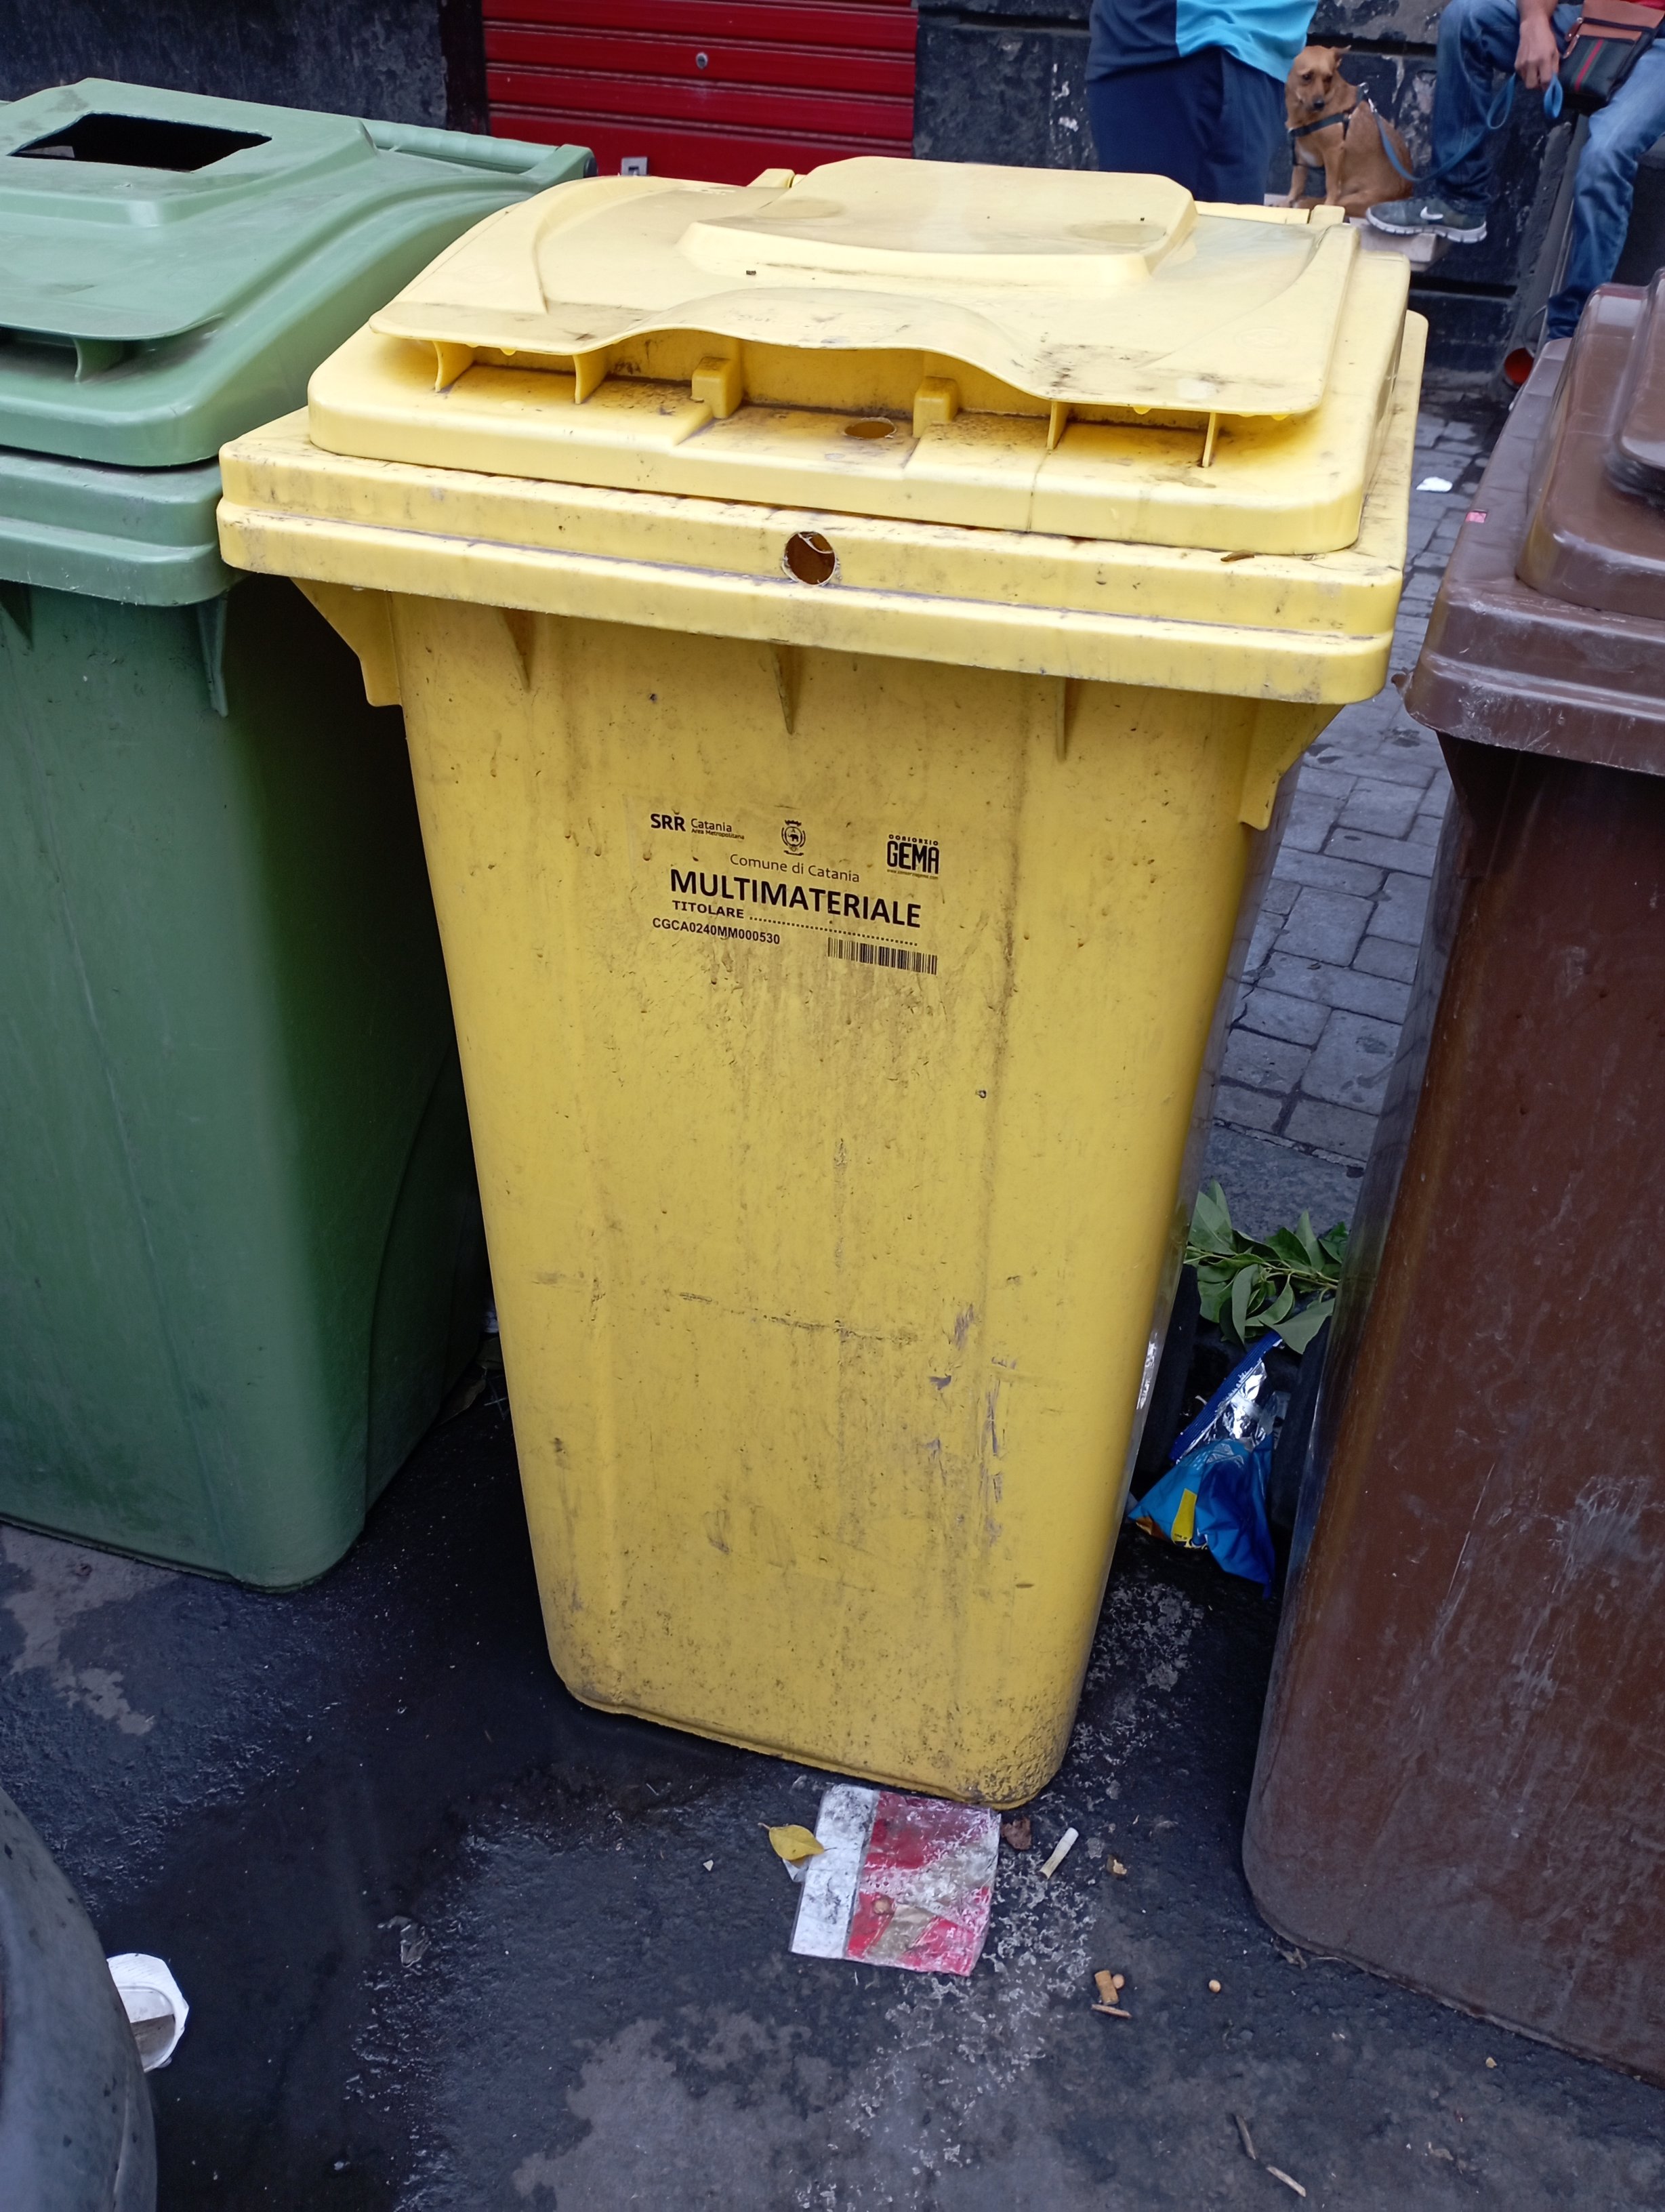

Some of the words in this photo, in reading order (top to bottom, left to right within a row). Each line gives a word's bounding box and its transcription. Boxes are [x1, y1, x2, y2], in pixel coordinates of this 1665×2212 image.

[651, 813, 686, 832] SRR
[691, 818, 732, 832] Catania
[730, 854, 787, 872] Comune
[792, 862, 804, 874] di
[808, 865, 860, 882] Catania
[886, 840, 939, 874] GEMA
[670, 869, 922, 928] MULTIMATERIALE
[672, 900, 745, 919] TITOLARE
[652, 917, 781, 945] CGCA0240MM000530
